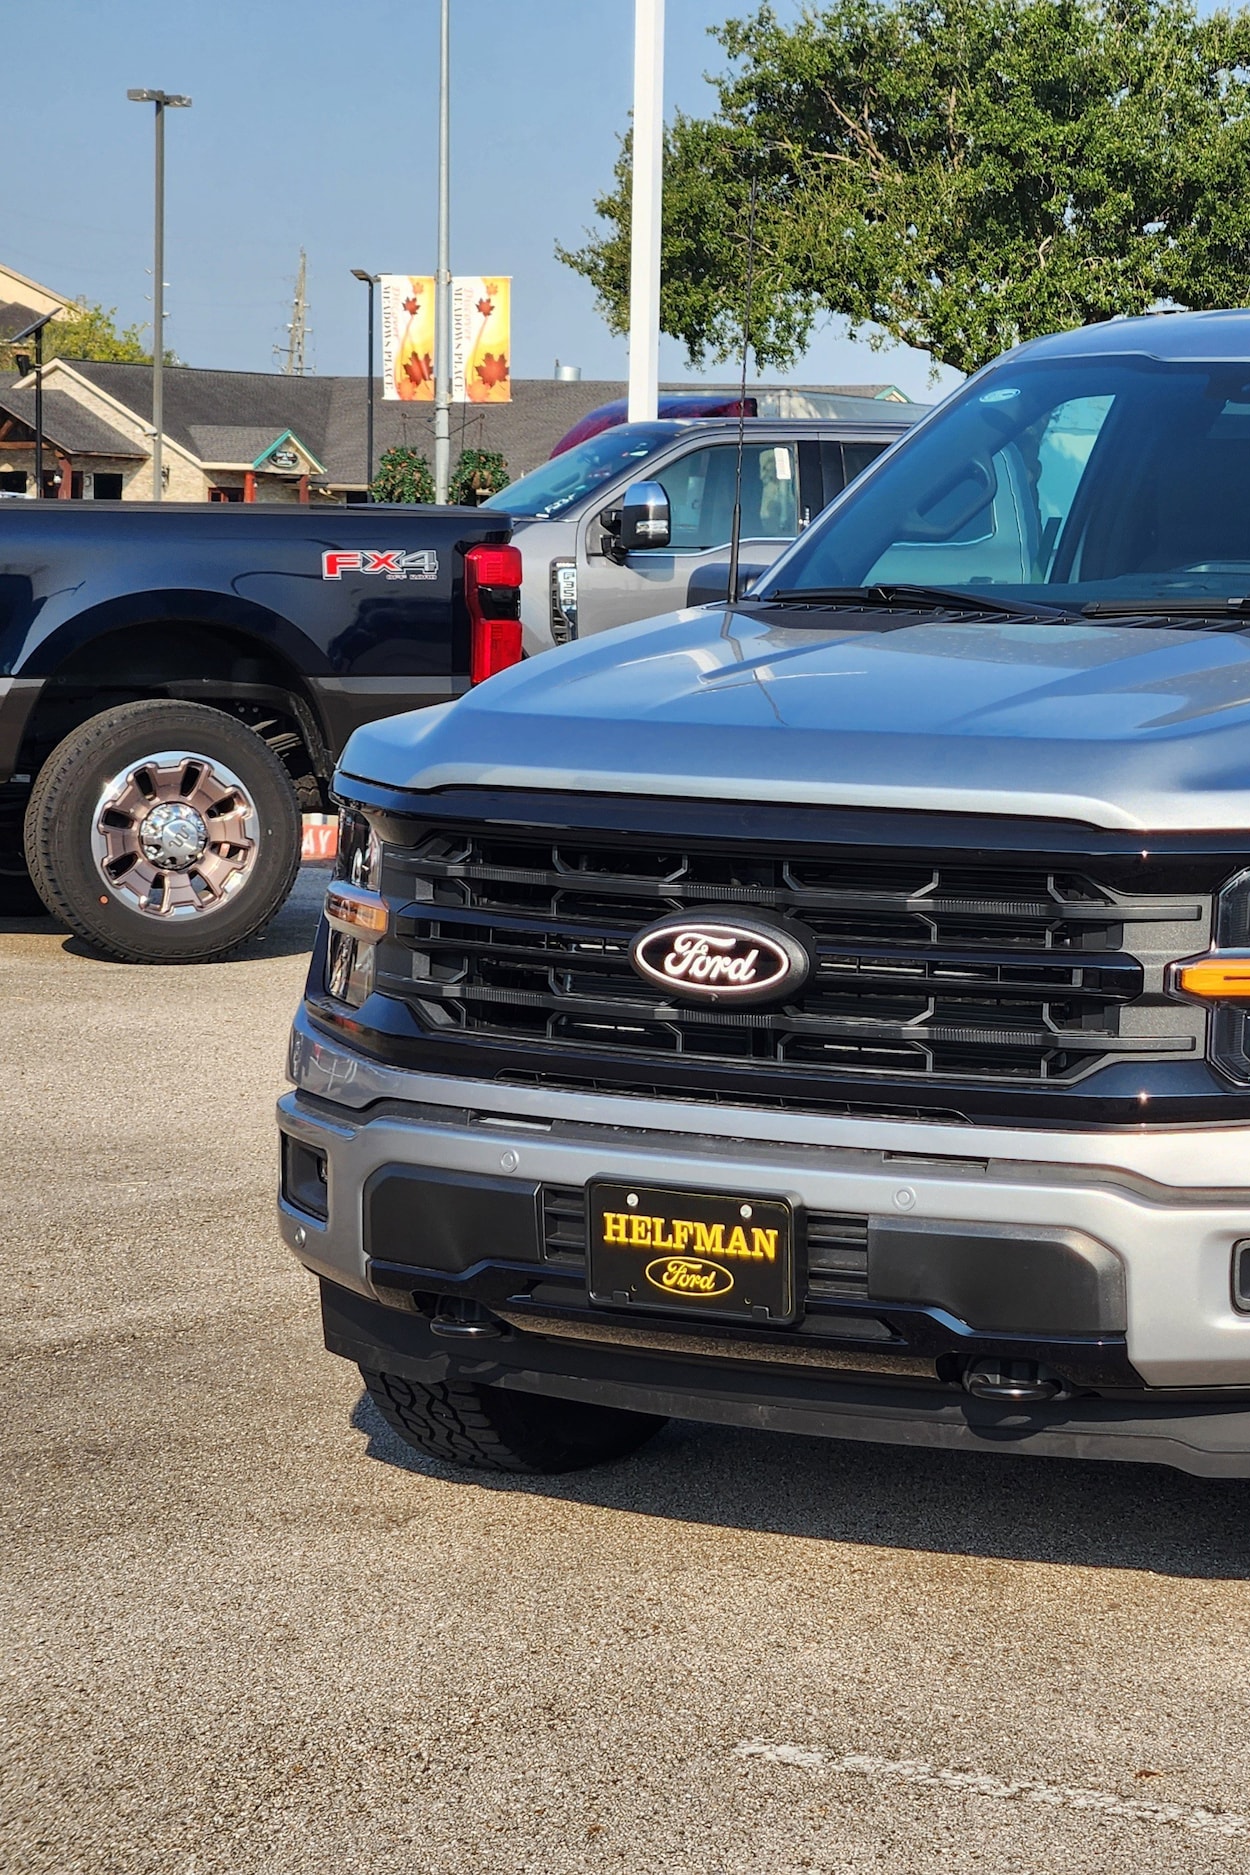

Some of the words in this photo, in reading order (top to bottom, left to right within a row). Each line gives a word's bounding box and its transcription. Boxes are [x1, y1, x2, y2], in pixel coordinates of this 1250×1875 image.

[383, 285, 392, 347] MEADOWS
[454, 287, 464, 349] MEADOWS
[384, 350, 394, 390] PLACE
[454, 352, 464, 392] PLACE
[321, 549, 439, 580] FX4
[664, 932, 760, 982] Ford
[602, 1211, 779, 1260] HELFMAN
[662, 1259, 717, 1290] Ford
